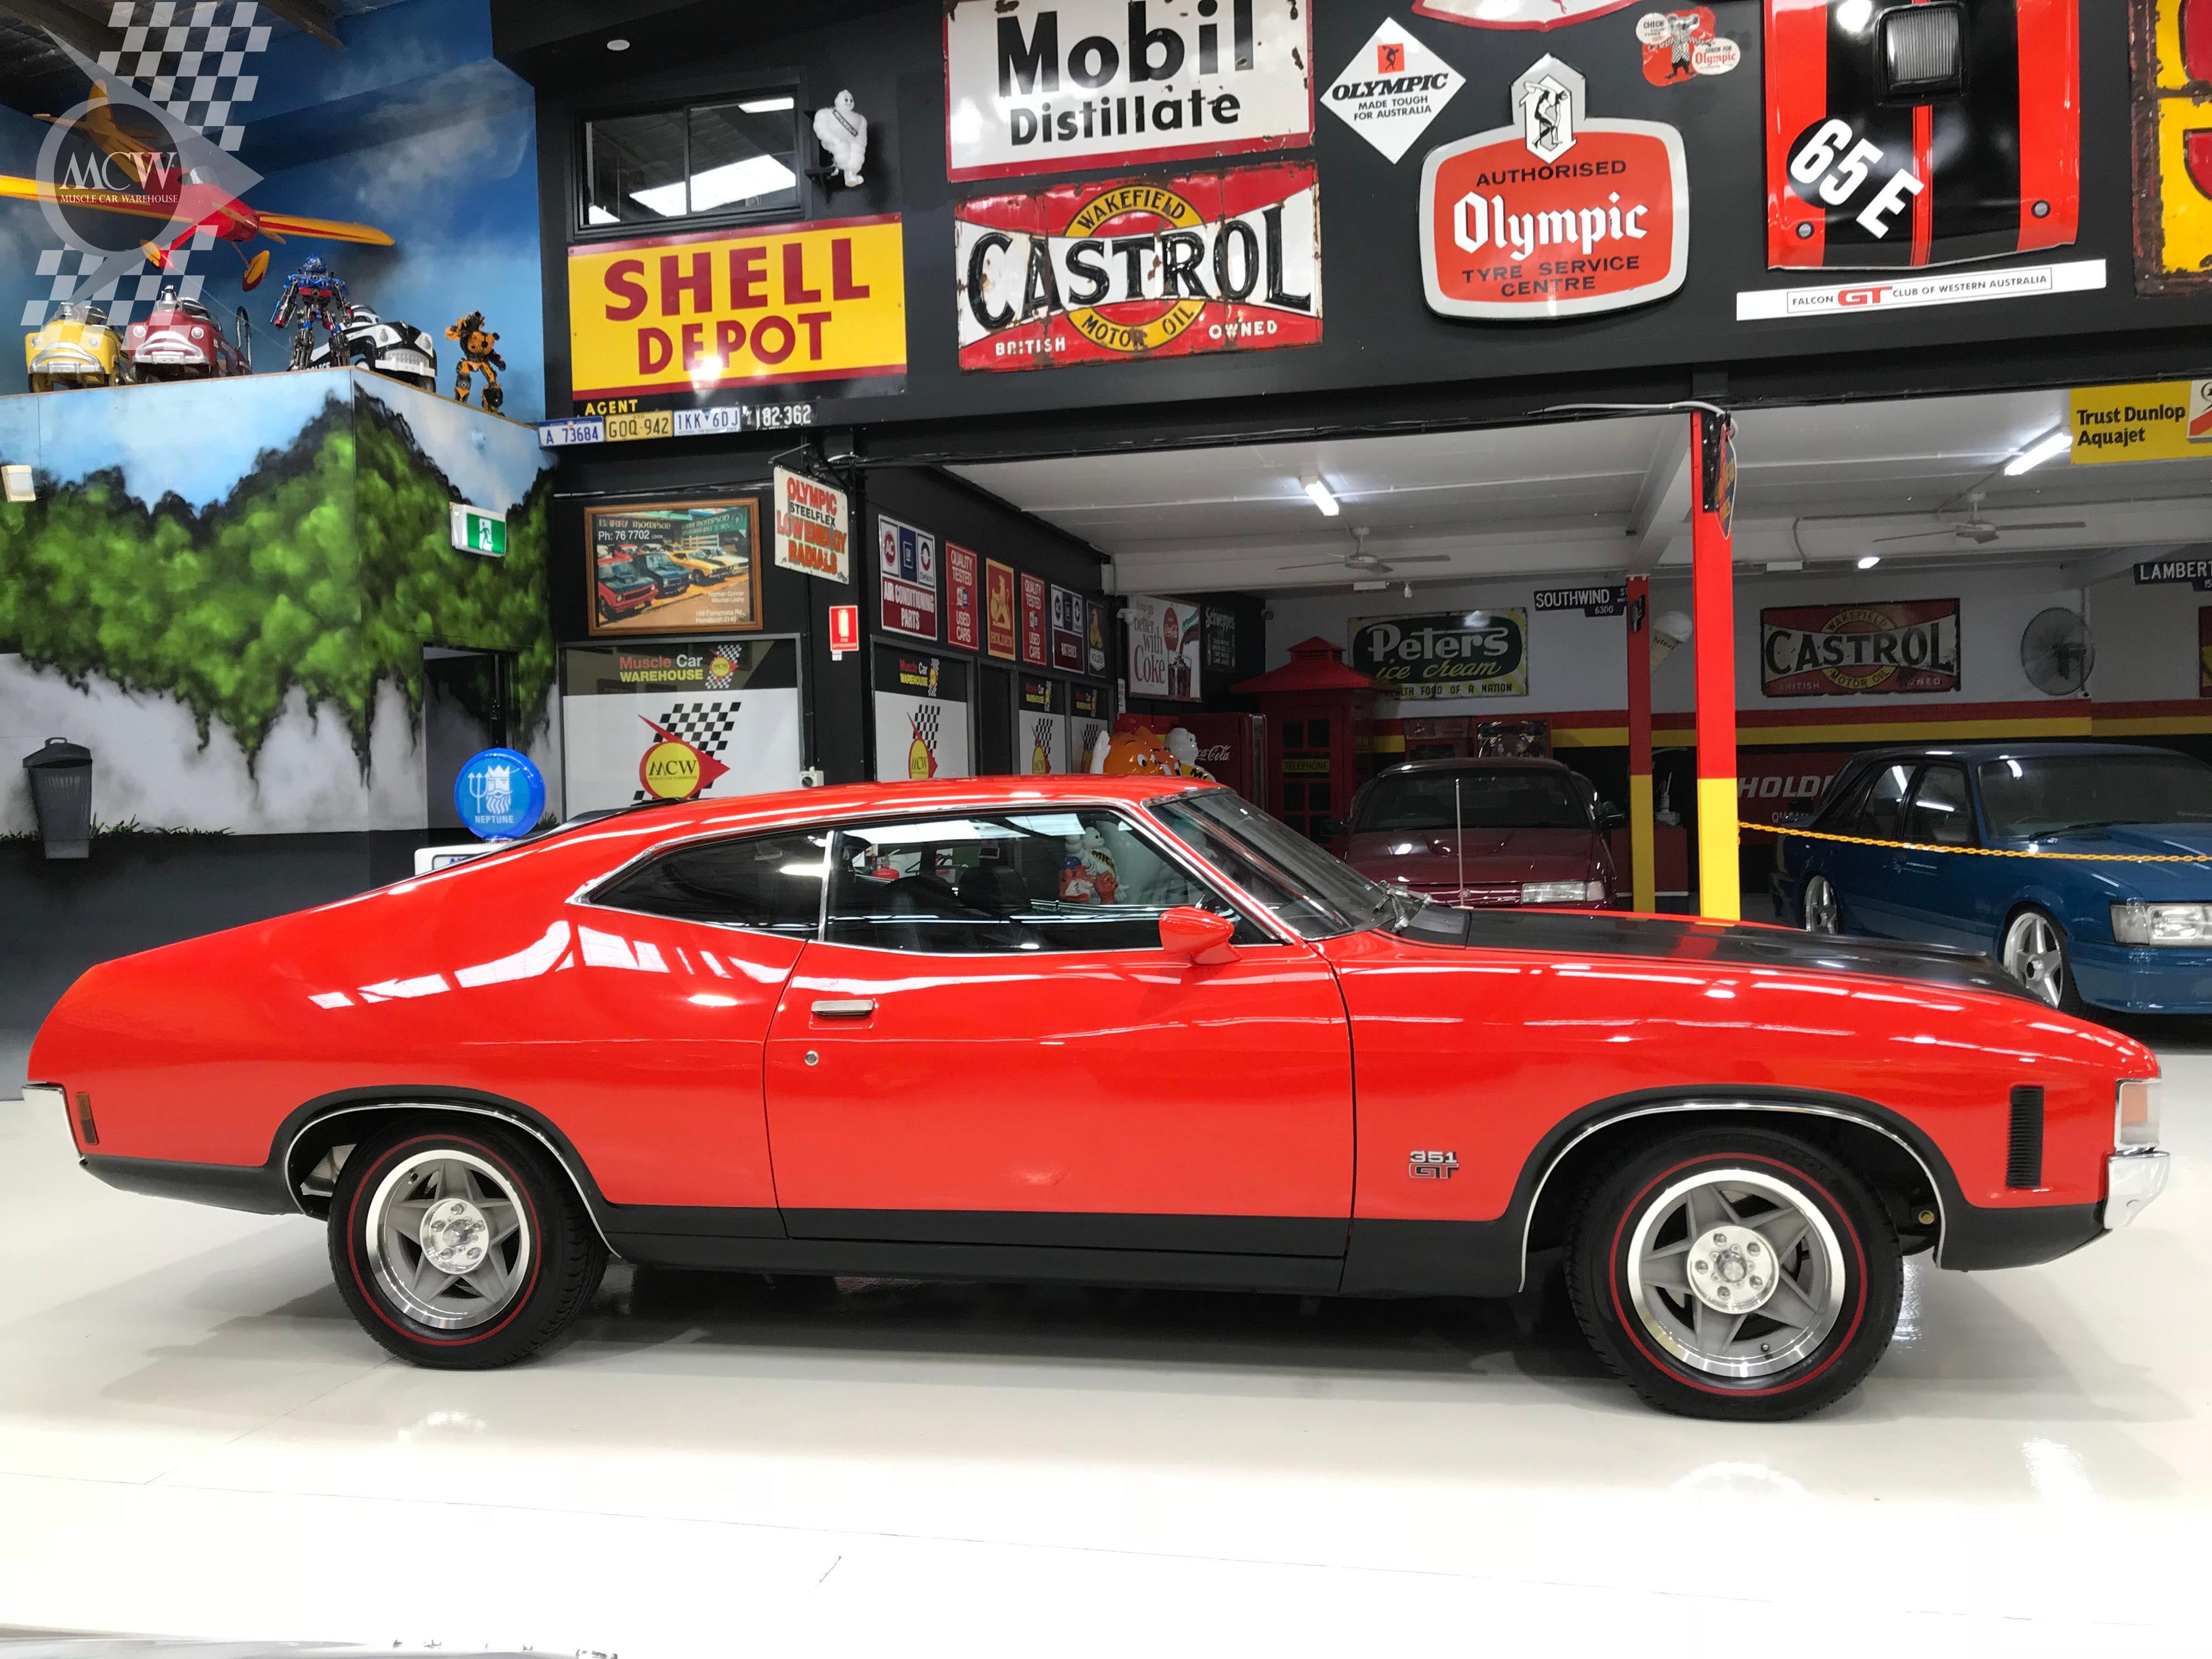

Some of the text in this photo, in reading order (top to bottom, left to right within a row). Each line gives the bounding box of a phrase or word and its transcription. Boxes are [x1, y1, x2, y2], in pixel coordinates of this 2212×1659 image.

[997, 0, 1253, 97] Mobil
[1695, 52, 1736, 65] Olympic
[1332, 73, 1449, 101] OLYMPIC
[1354, 105, 1431, 121] FOR AUSTRALIA
[1358, 96, 1427, 110] MADE TOUGH
[1010, 90, 1240, 146] Distillate
[1476, 160, 1627, 187] AUTHORISED
[1078, 188, 1186, 230] WAKEFIELD
[1453, 191, 1649, 262] Olympic
[604, 238, 870, 321] SHELL
[967, 206, 1311, 331] CASTROL
[1463, 256, 1639, 283] TYRE SERVICE
[1501, 275, 1596, 297] CENTRE
[1793, 275, 2047, 306] FALCON GT CLUB OF WESTERN AUSTRALIA
[995, 320, 1277, 356] BRITISH OWNED
[1082, 306, 1195, 350] MOTOR OIL
[638, 311, 832, 375] DEPOT
[585, 399, 638, 416] AGENT
[2077, 404, 2186, 426] Trust Dunlop
[2077, 427, 2145, 448] Aquajet
[787, 477, 837, 516] OLYMPIC
[777, 510, 803, 540] LOW
[790, 502, 836, 528] STEELFLEX
[598, 531, 613, 541] Ph:
[615, 531, 626, 540] 76
[629, 530, 650, 540] 7702
[788, 539, 838, 574] RADIALS
[885, 540, 894, 556] AC
[951, 550, 973, 571] QUALITY
[952, 567, 972, 586] TESTED
[884, 581, 934, 613] AIR CONDITIONING
[1535, 589, 1610, 608] SOUTHWIND
[901, 608, 920, 631] PARTS
[956, 611, 971, 627] USED
[1827, 609, 1890, 630] WAKEFIELD
[956, 626, 971, 642] CARS
[1143, 627, 1162, 654] with
[1366, 624, 1509, 662] Peters
[1766, 622, 1955, 675] CASTROL
[619, 654, 703, 669] Muscle Car
[918, 662, 927, 675] Car
[1134, 645, 1165, 684] Coke
[1374, 658, 1502, 680] ice cream
[620, 669, 703, 683] WAREHOUSE
[1830, 671, 1890, 687] MOTOR OIL
[1421, 685, 1442, 695] FOOD
[1450, 685, 1460, 694] OF
[1468, 685, 1474, 693] A
[1482, 683, 1513, 693] NATION
[649, 760, 697, 775] MCW
[1285, 761, 1328, 770] TELEPHONE
[475, 815, 514, 824] NEPTUNE
[1410, 1150, 1457, 1163] 351
[1408, 1162, 1459, 1179] GT
